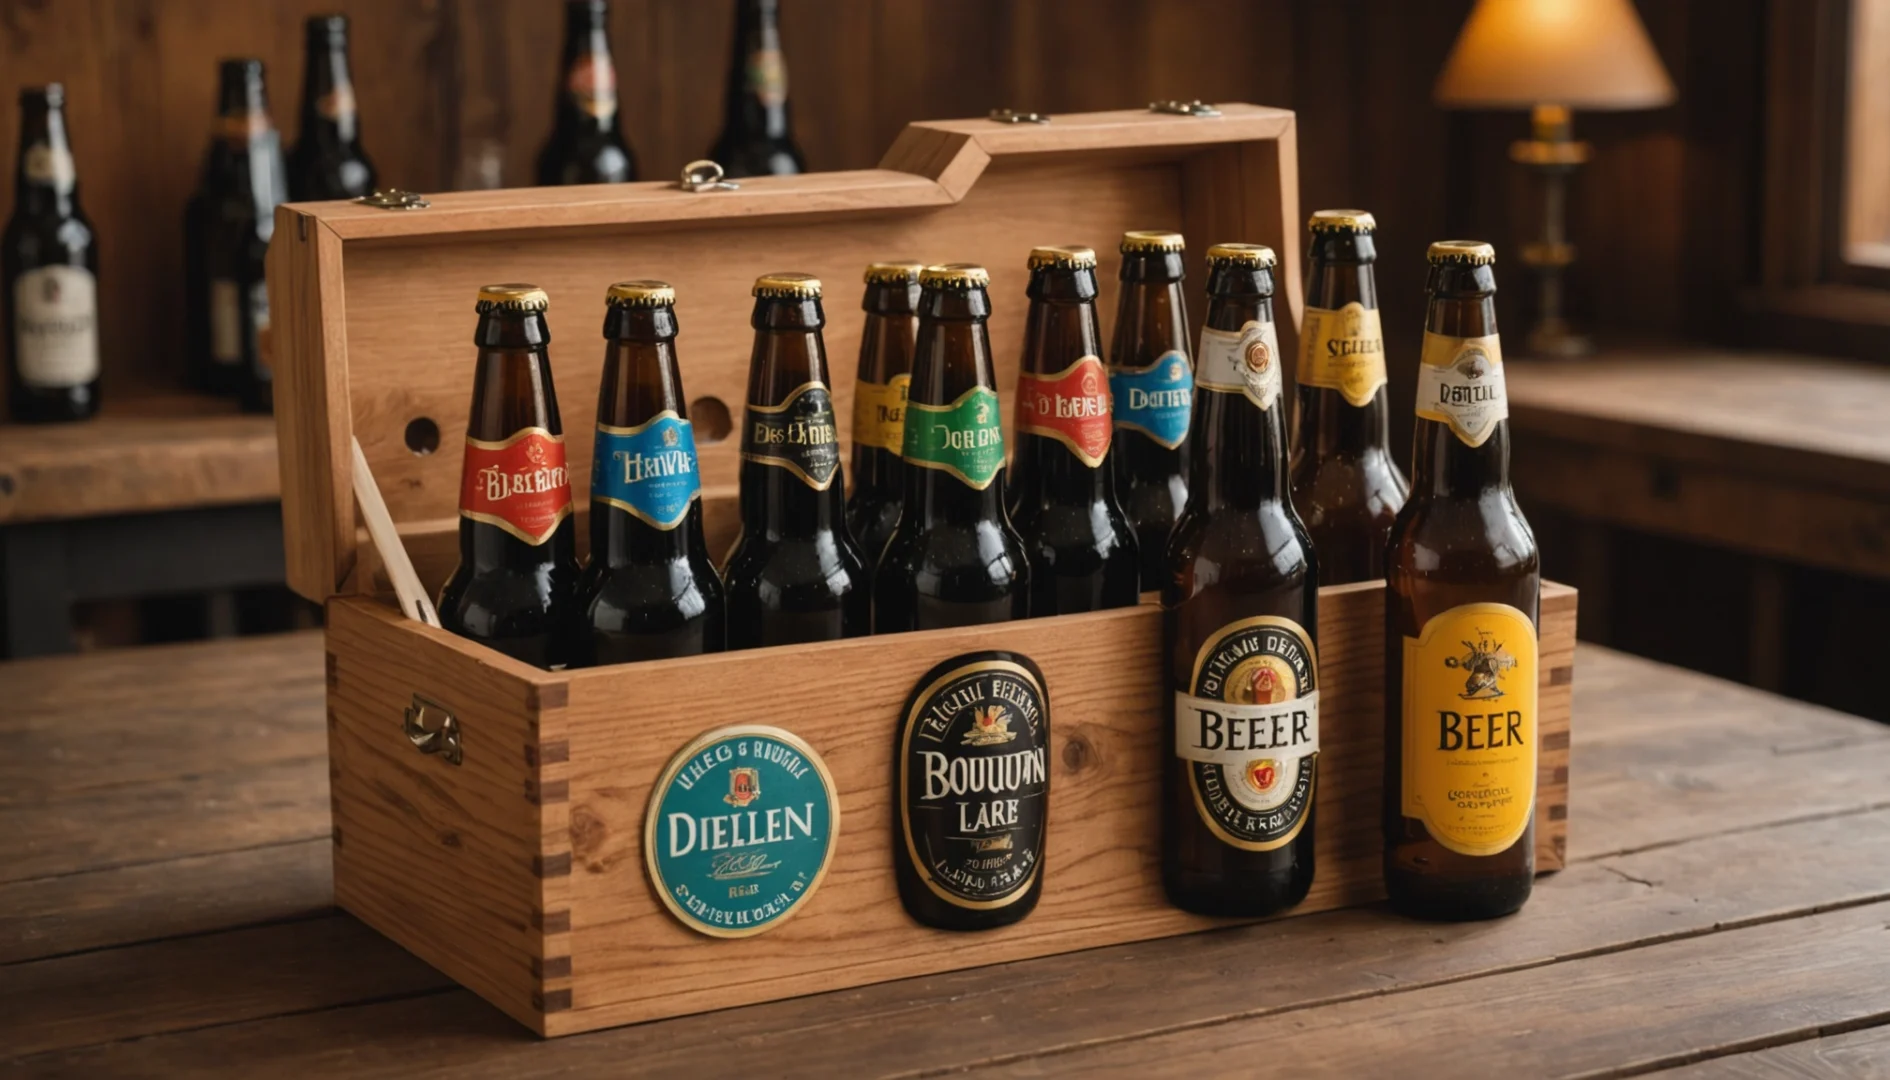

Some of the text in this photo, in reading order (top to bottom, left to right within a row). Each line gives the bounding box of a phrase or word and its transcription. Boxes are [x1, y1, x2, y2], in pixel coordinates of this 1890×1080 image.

[1190, 709, 1311, 751] BEEER
[1437, 710, 1524, 751] BEER
[667, 802, 815, 858] DIELLEN
